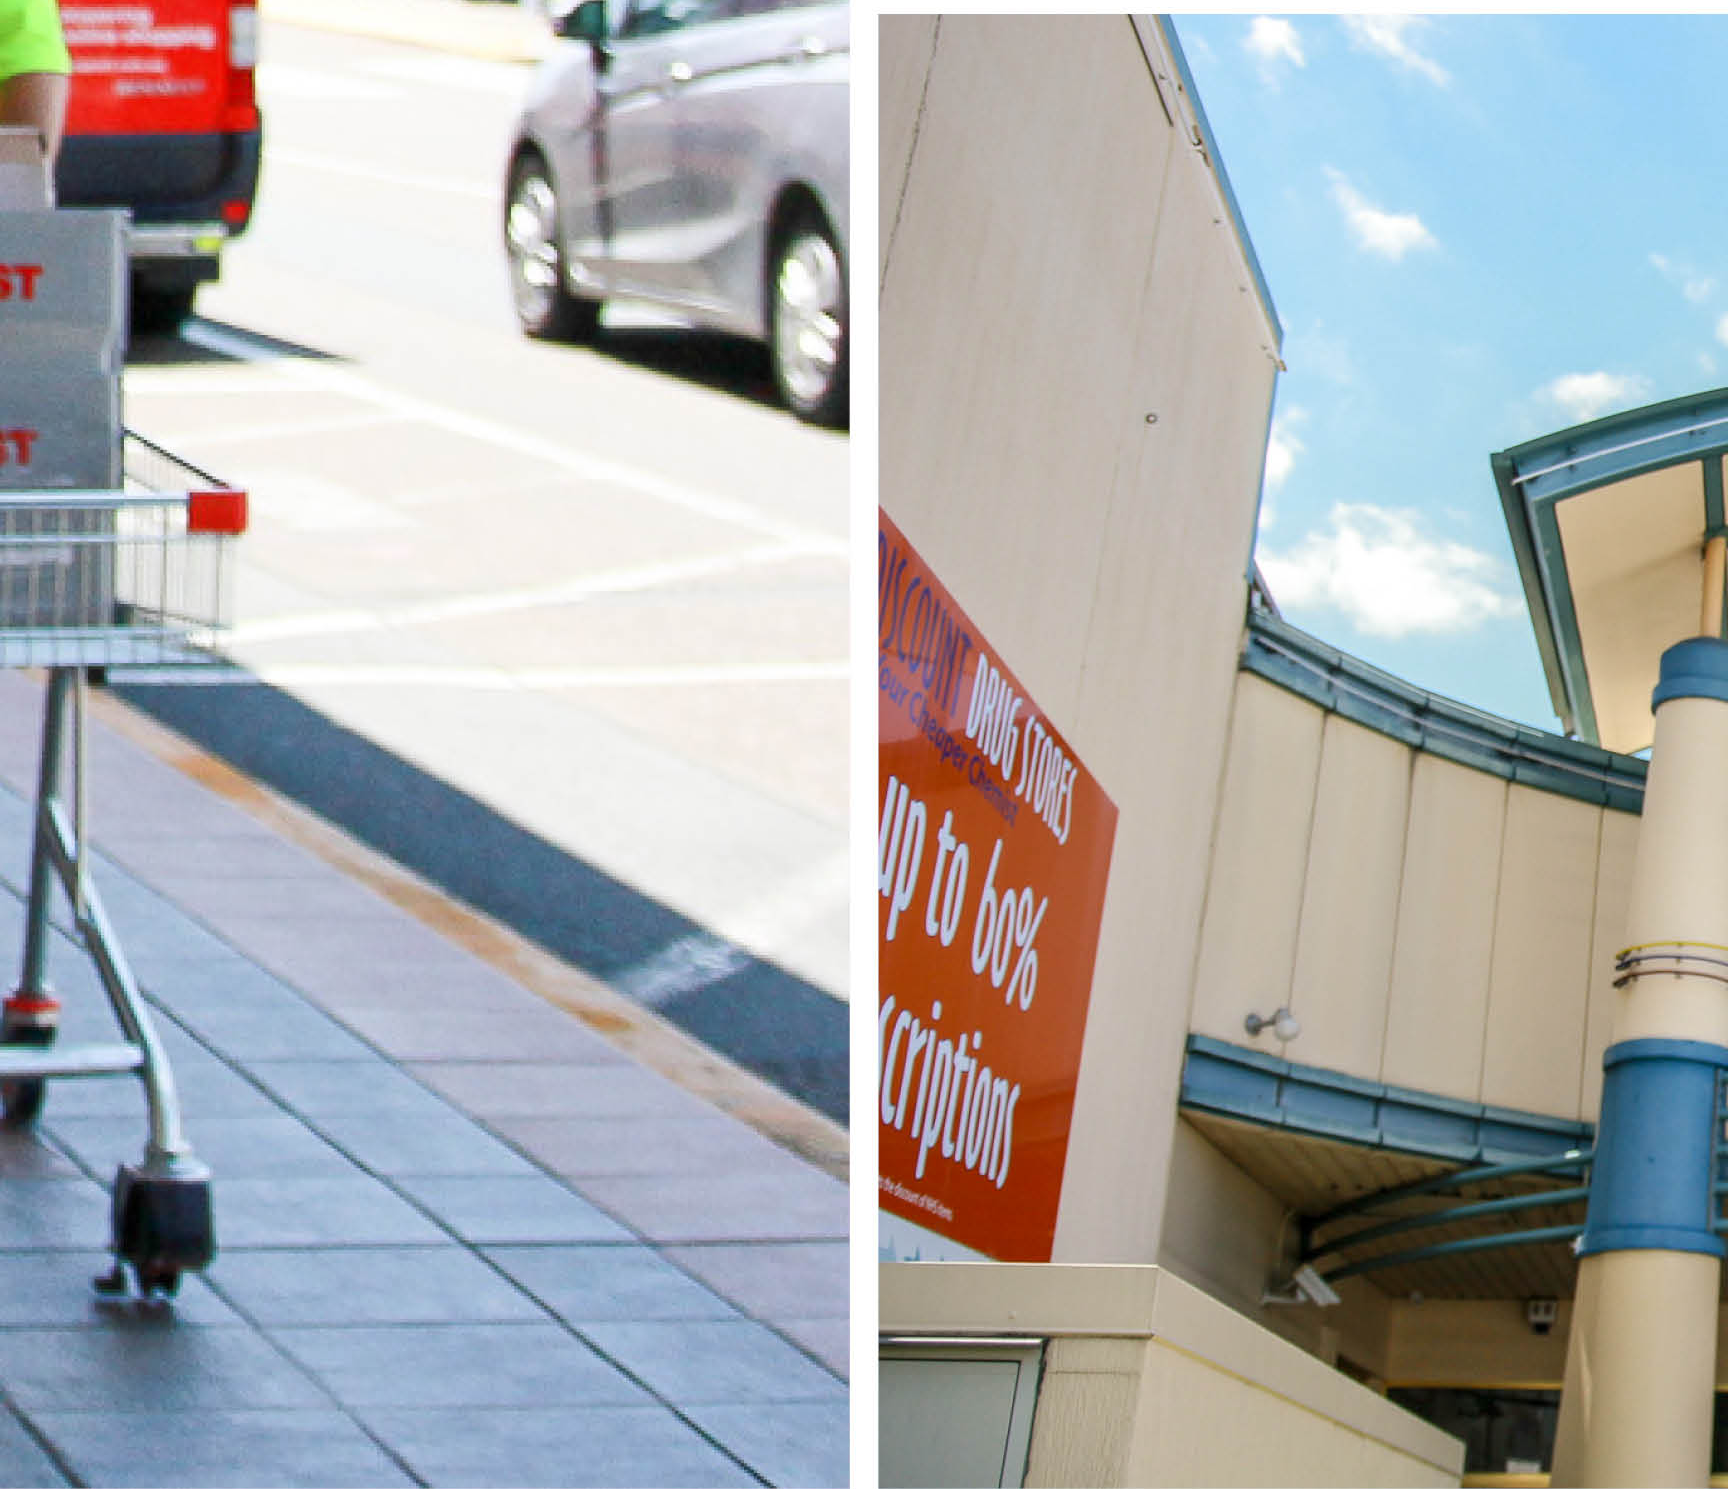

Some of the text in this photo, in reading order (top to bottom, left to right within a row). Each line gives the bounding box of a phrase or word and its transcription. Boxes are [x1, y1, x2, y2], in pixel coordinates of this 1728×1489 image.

[908, 691, 969, 771] Cheaper
[968, 756, 1020, 828] Chemist
[966, 652, 1023, 781] DRUG
[1015, 715, 1078, 846] STORES
[878, 775, 1048, 1011] up to 60%
